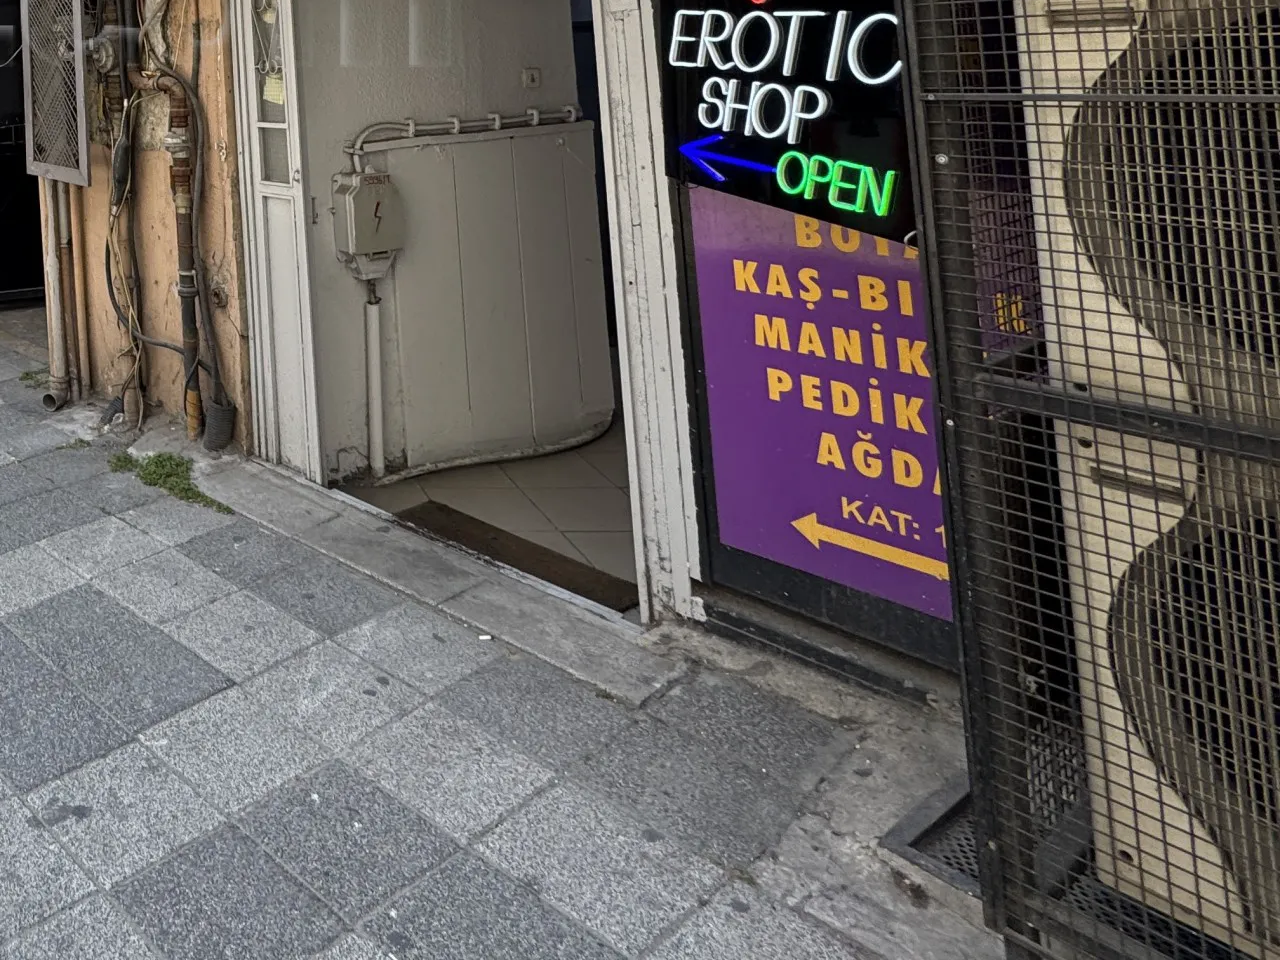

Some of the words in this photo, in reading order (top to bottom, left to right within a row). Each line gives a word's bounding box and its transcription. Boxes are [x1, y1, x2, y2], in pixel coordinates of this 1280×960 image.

[669, 9, 903, 86] EROTIC
[698, 76, 831, 144] SHOP
[775, 150, 897, 217] OPEN
[753, 313, 932, 379] MANİK
[766, 366, 929, 435] PEDİK
[841, 496, 921, 541] KAT:
